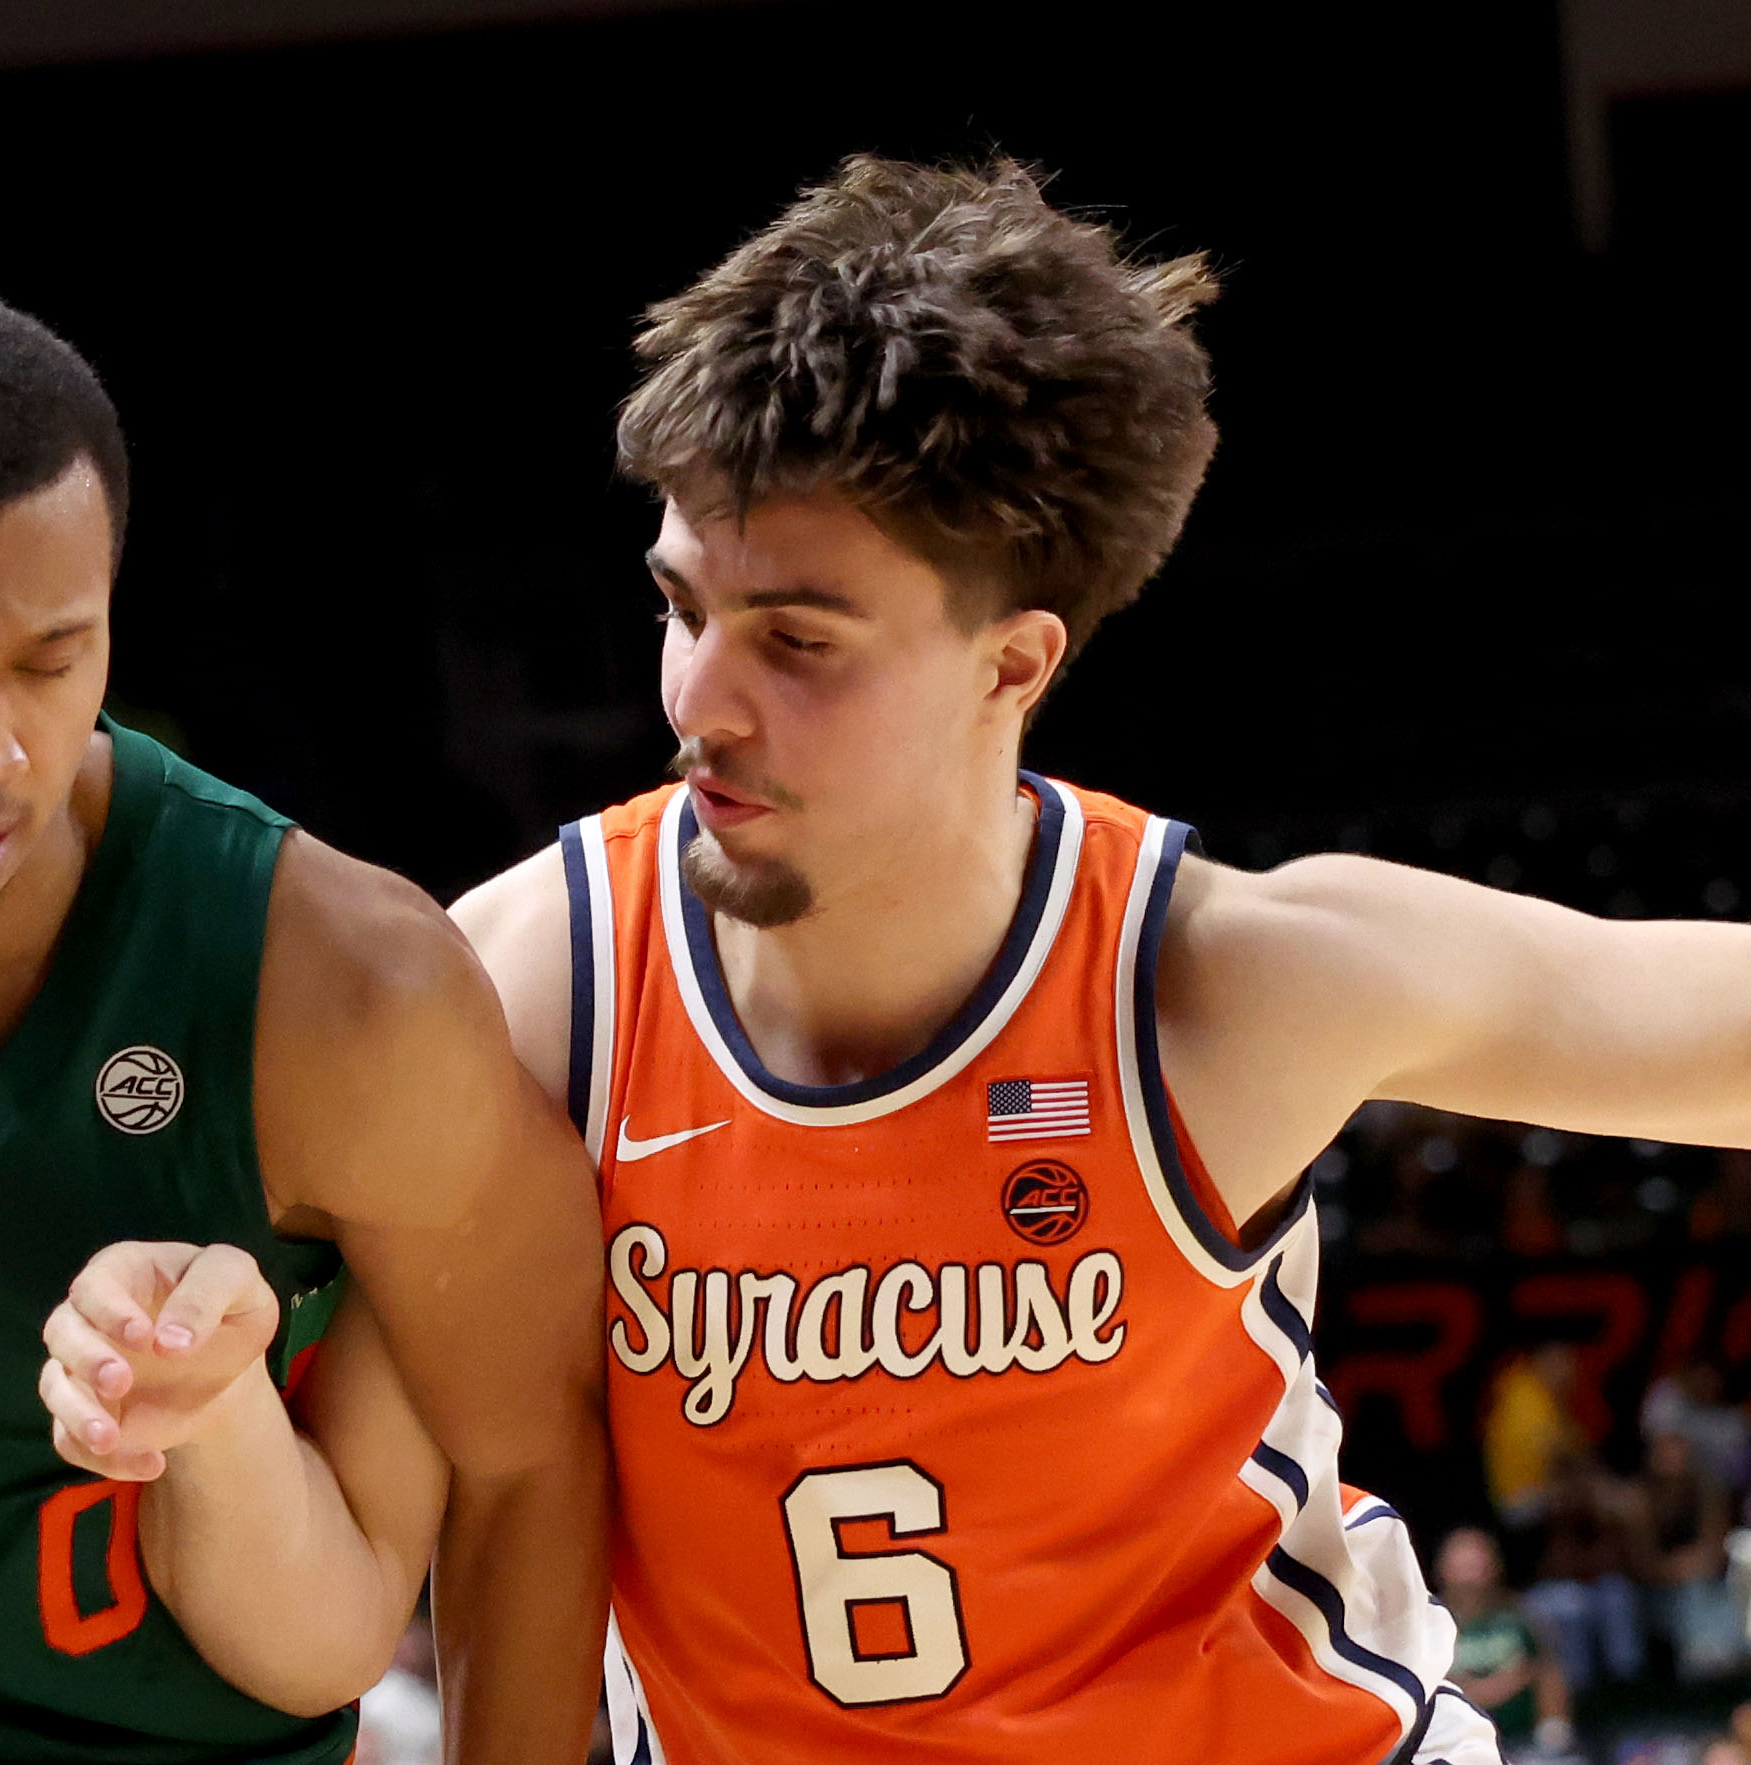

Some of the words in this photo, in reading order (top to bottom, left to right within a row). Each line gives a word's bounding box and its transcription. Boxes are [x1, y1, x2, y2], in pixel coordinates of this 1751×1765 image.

[109, 1075, 178, 1096] ACC
[1016, 1187, 1080, 1208] ACC
[605, 1222, 1128, 1428] Syracuse
[36, 1475, 150, 1658] 0
[778, 1457, 973, 1710] 6
